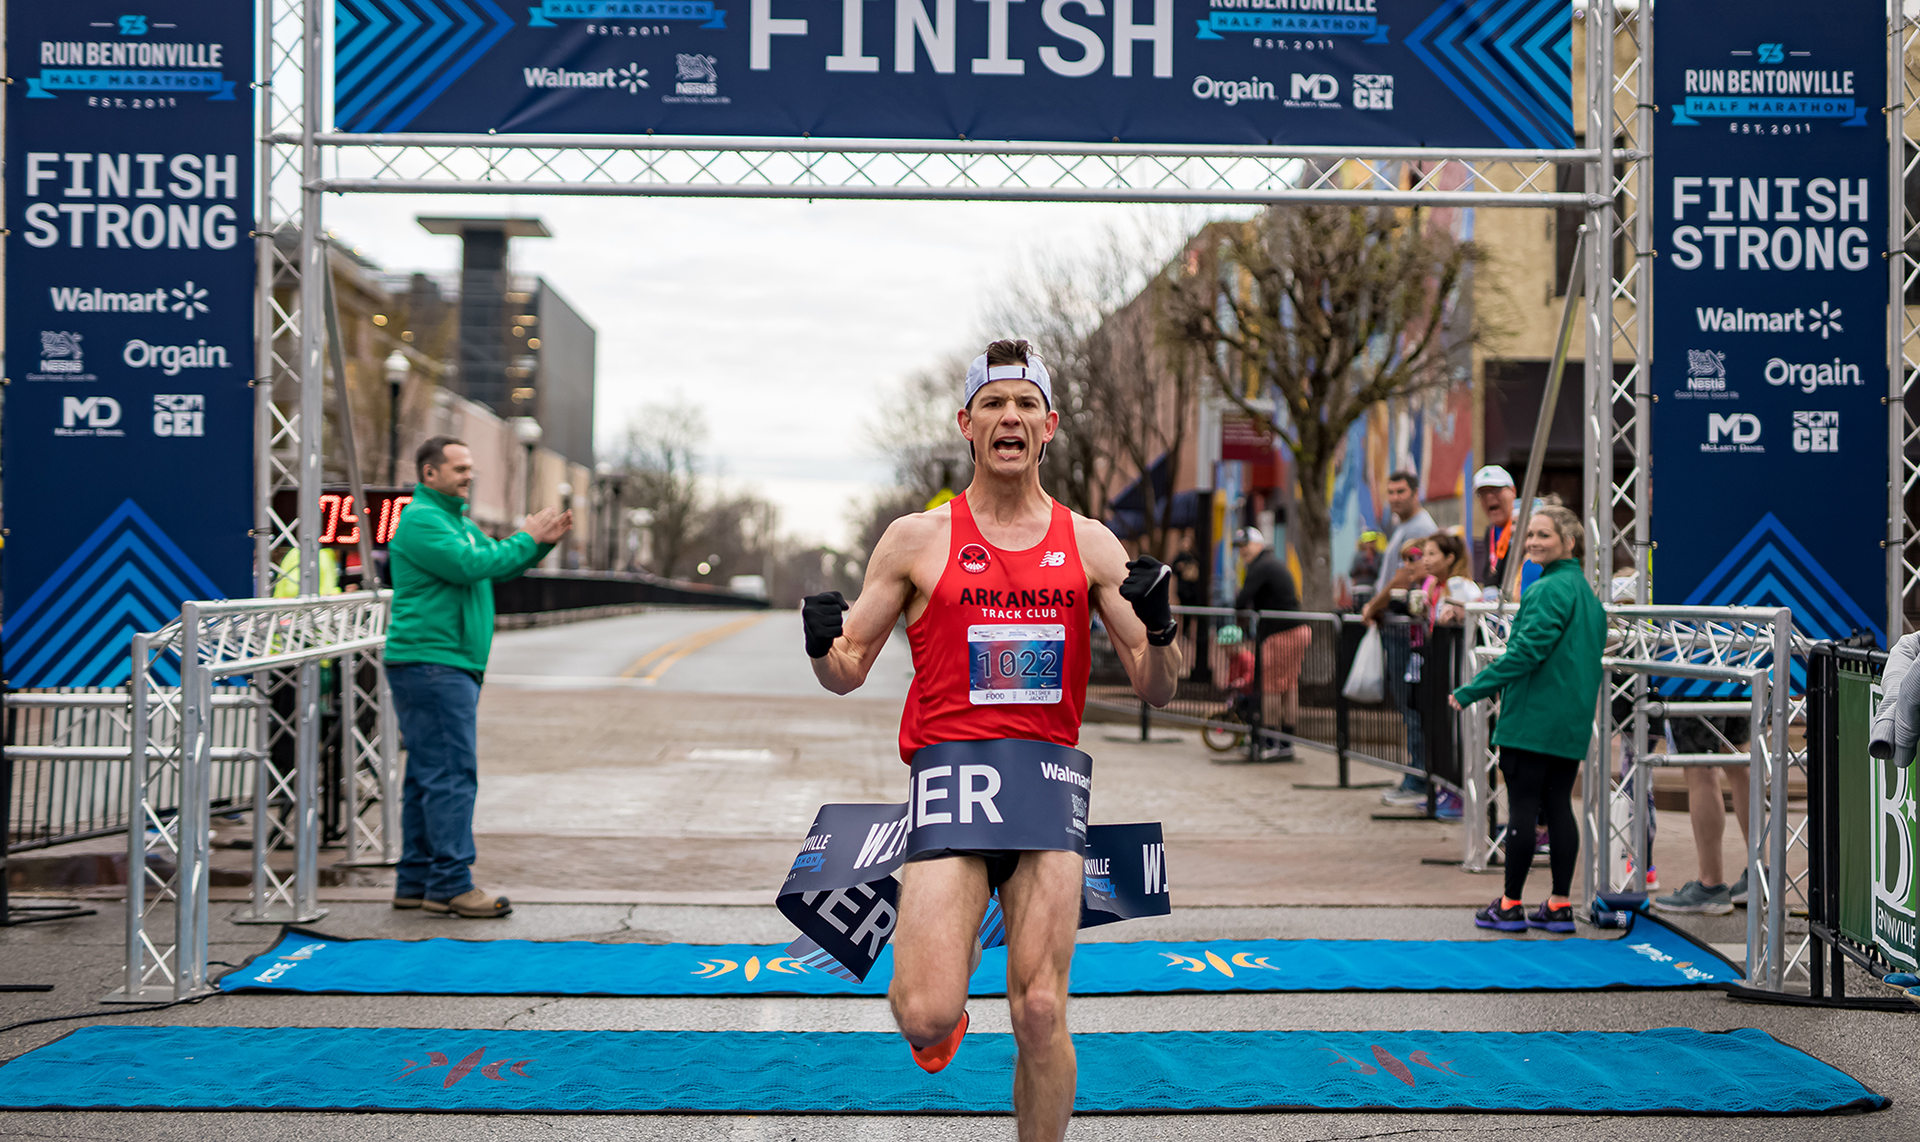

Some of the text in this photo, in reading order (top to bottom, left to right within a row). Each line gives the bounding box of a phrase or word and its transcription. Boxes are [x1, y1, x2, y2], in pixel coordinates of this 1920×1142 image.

[550, 2, 707, 17] HALF MARATHON
[1217, 16, 1370, 31] HALF MARATHON
[40, 41, 223, 67] RUN BENTONVILLE
[50, 74, 214, 87] HALF MARATHON
[523, 67, 618, 88] Walmart
[1192, 75, 1276, 106] Orgain
[1290, 73, 1340, 101] MD
[1684, 69, 1855, 94] RUN BENTONVILLE
[132, 97, 177, 109] 2011
[1352, 88, 1394, 110] CEI
[1693, 101, 1848, 113] HALF MARATHON
[1771, 123, 1811, 135] 2011
[26, 152, 237, 199] FINISH
[1672, 176, 1868, 222] FINISH
[24, 203, 237, 250] STRONG
[1671, 225, 1869, 271] STRONG
[50, 286, 168, 313] Walmart
[1696, 307, 1804, 333] Walmart
[123, 338, 227, 376] Orgain
[1764, 357, 1860, 394] Orgain
[63, 396, 122, 428] MD
[154, 411, 204, 437] CEI
[1708, 412, 1762, 444] MD
[1793, 427, 1838, 453] CEI
[960, 588, 1076, 608] ARKANSAS
[981, 608, 1057, 619] TRACK CLUB
[977, 649, 1058, 678] 1022
[908, 764, 1004, 834] ER
